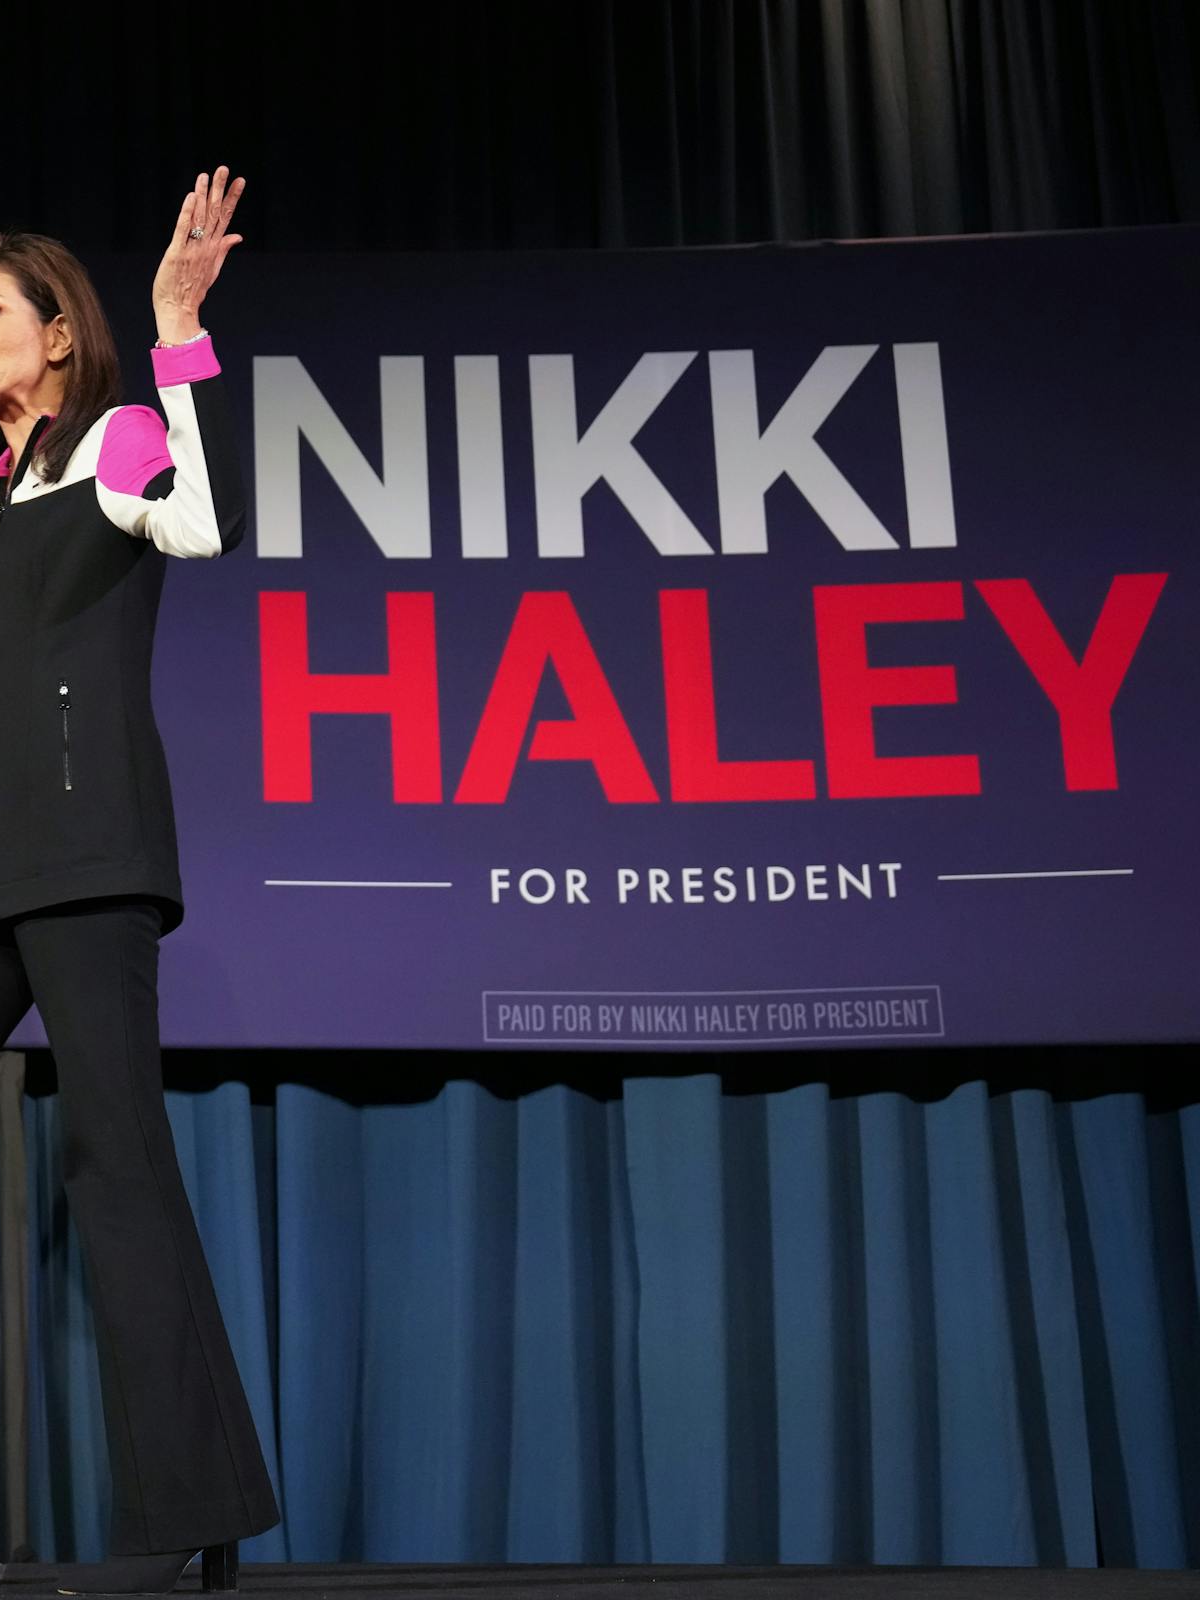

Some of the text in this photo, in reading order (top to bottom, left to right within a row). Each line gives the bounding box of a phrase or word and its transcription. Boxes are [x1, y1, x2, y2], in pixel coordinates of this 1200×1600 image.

[253, 342, 958, 559] NIKKI
[258, 573, 1168, 805] HALEY
[490, 862, 902, 905] FOR PRESIDENT
[498, 998, 930, 1033] PAID FOR BY NIKKI HALEY FOR PRESIDENT
